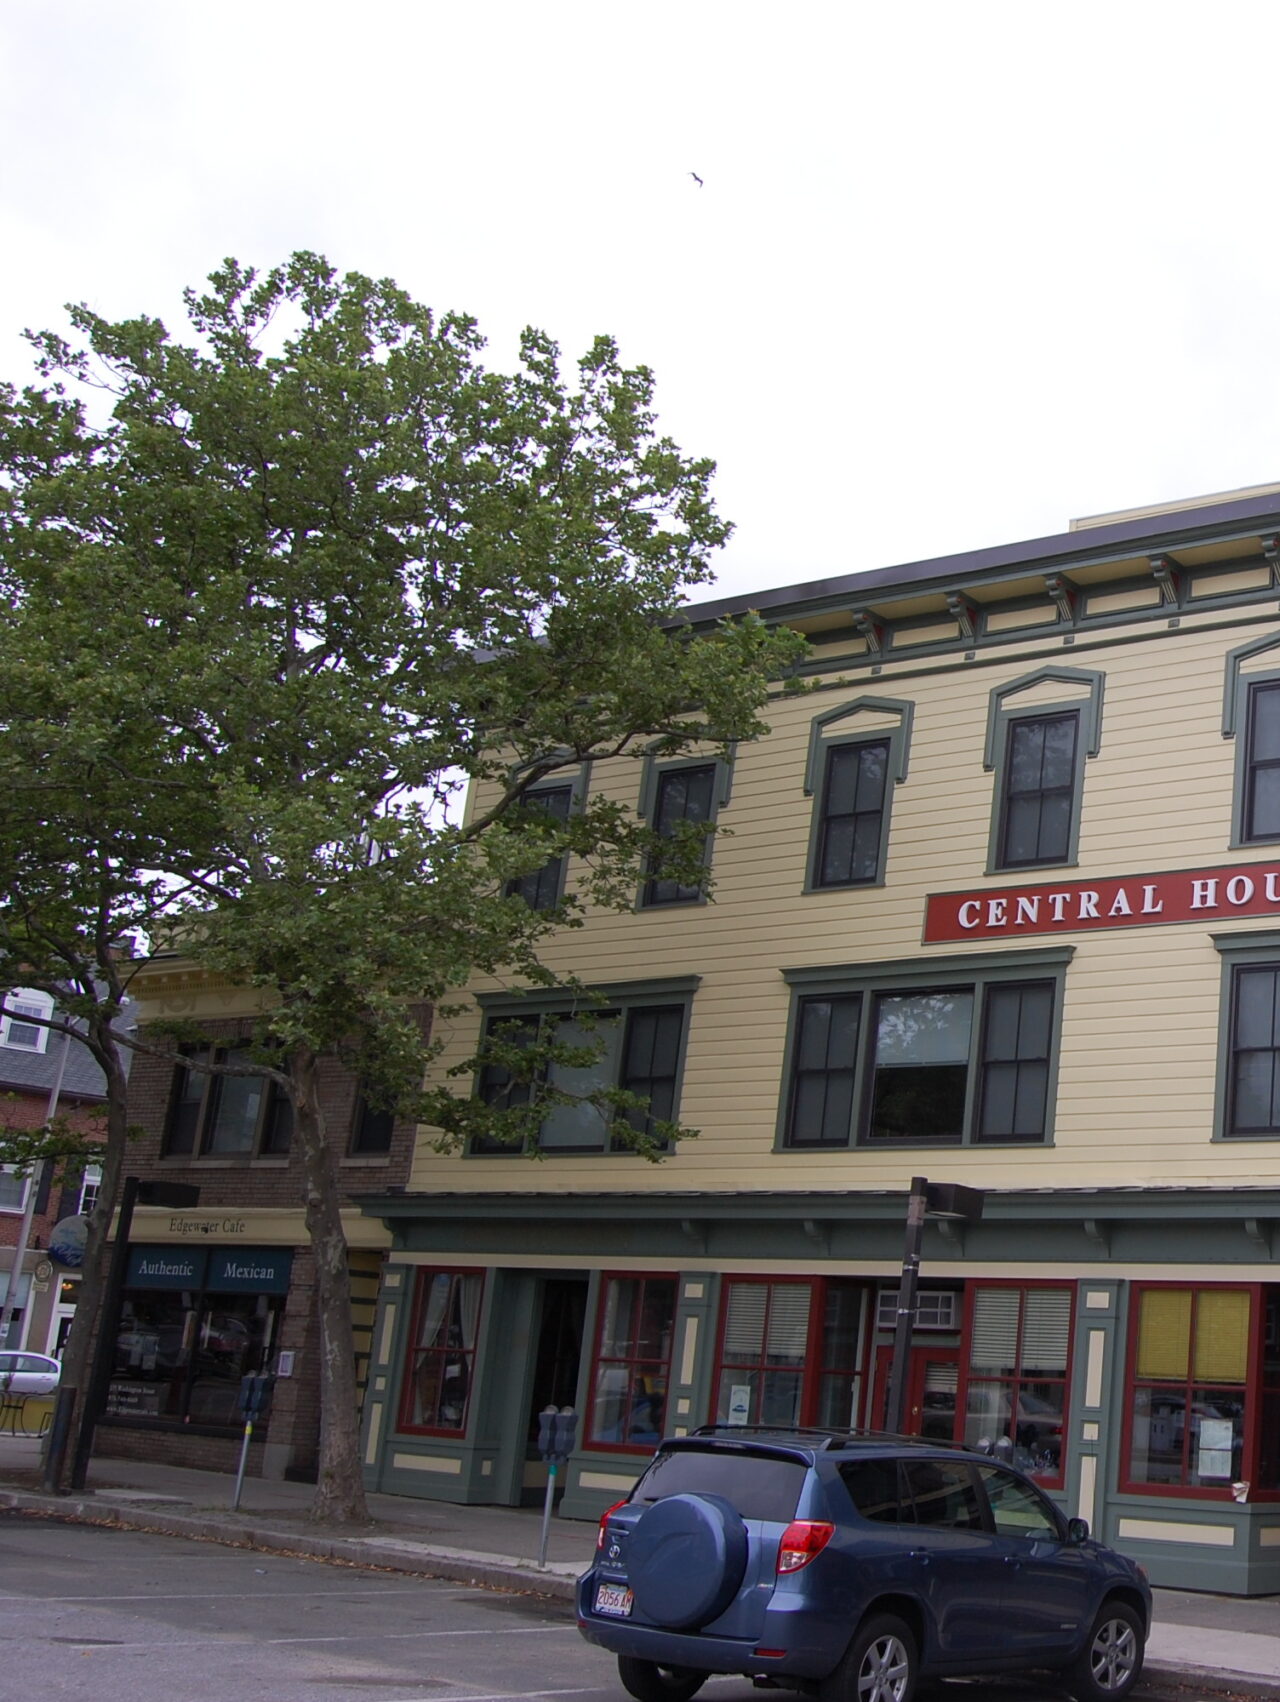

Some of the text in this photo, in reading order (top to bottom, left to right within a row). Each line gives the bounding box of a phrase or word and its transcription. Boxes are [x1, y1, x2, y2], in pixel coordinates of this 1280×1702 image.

[958, 884, 1163, 929] CENTRAL
[169, 1217, 246, 1235] Edgewater Cafe
[138, 1259, 194, 1277] Authentic
[223, 1262, 275, 1280] Mexican
[597, 1590, 620, 1607] 2056
